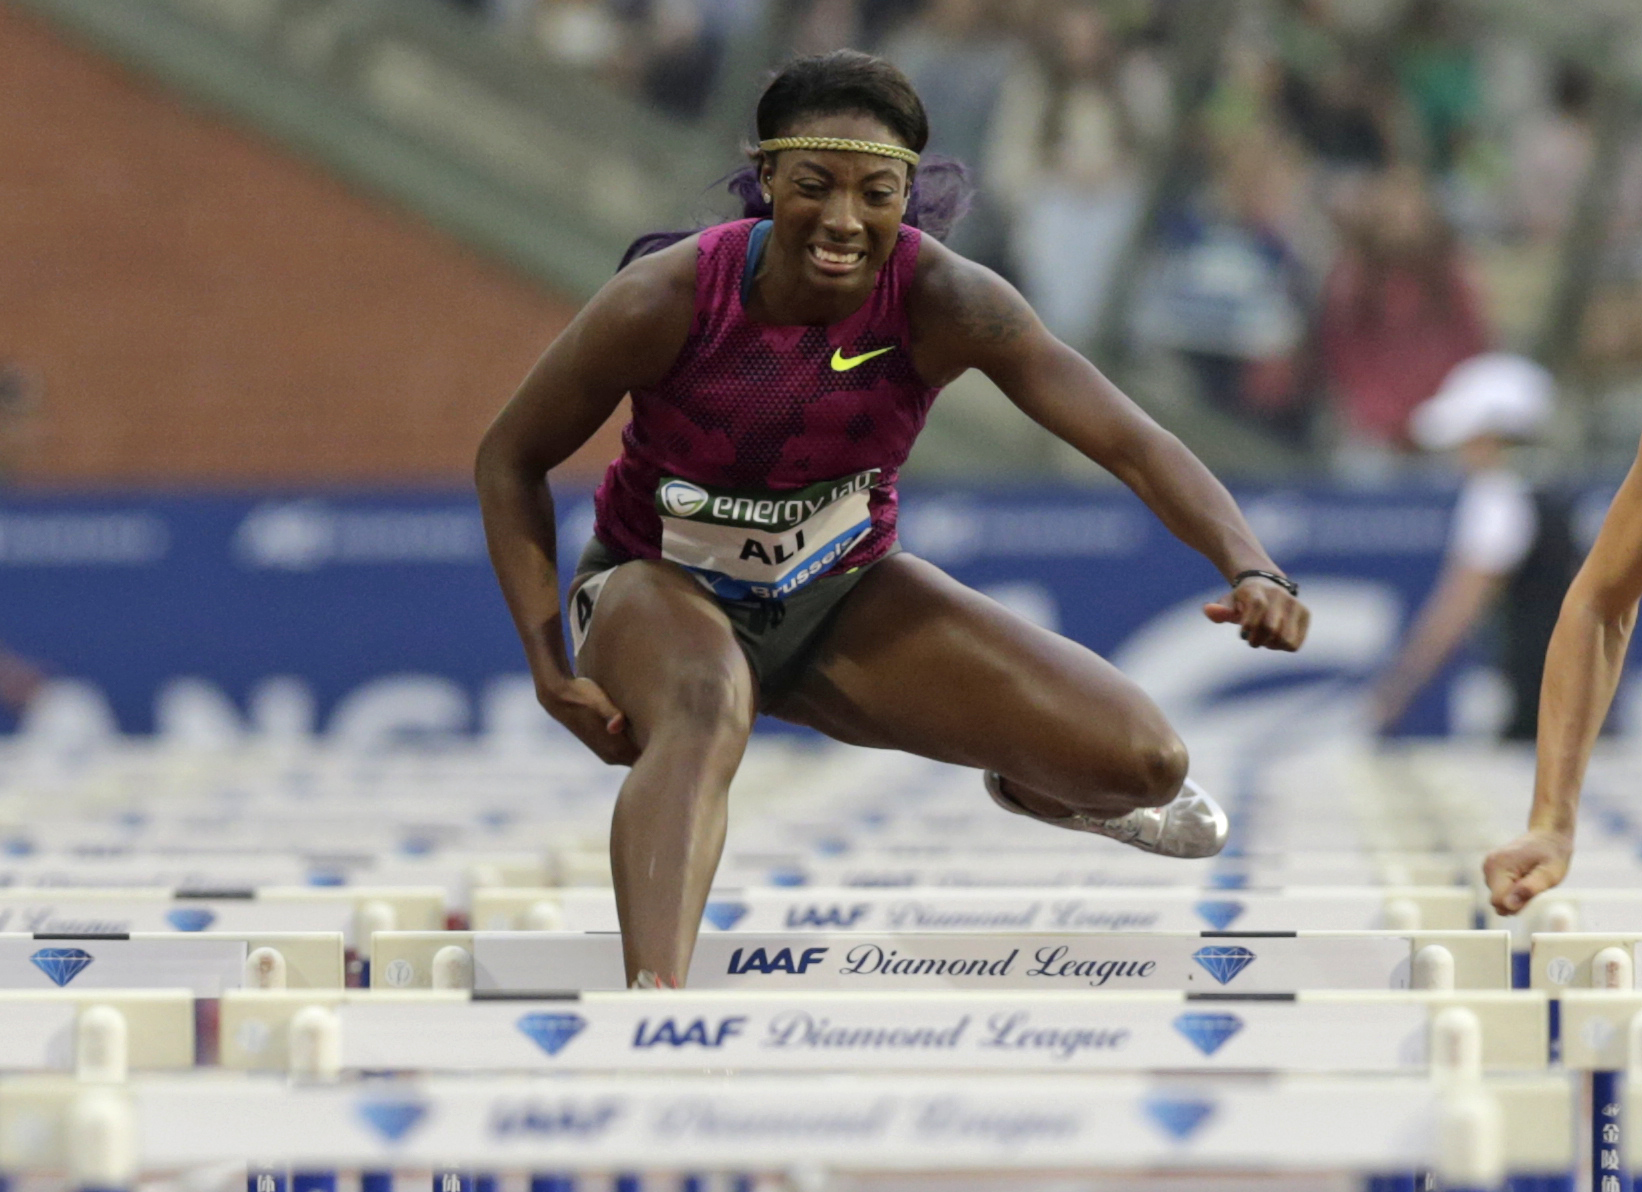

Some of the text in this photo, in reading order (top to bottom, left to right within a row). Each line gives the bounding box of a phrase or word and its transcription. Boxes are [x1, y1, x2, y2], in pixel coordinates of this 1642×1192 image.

[712, 494, 825, 526] energy
[739, 529, 806, 565] ALI
[726, 943, 1157, 987] IAAF Diamond League
[632, 1009, 1132, 1058] IAAF Diamond League
